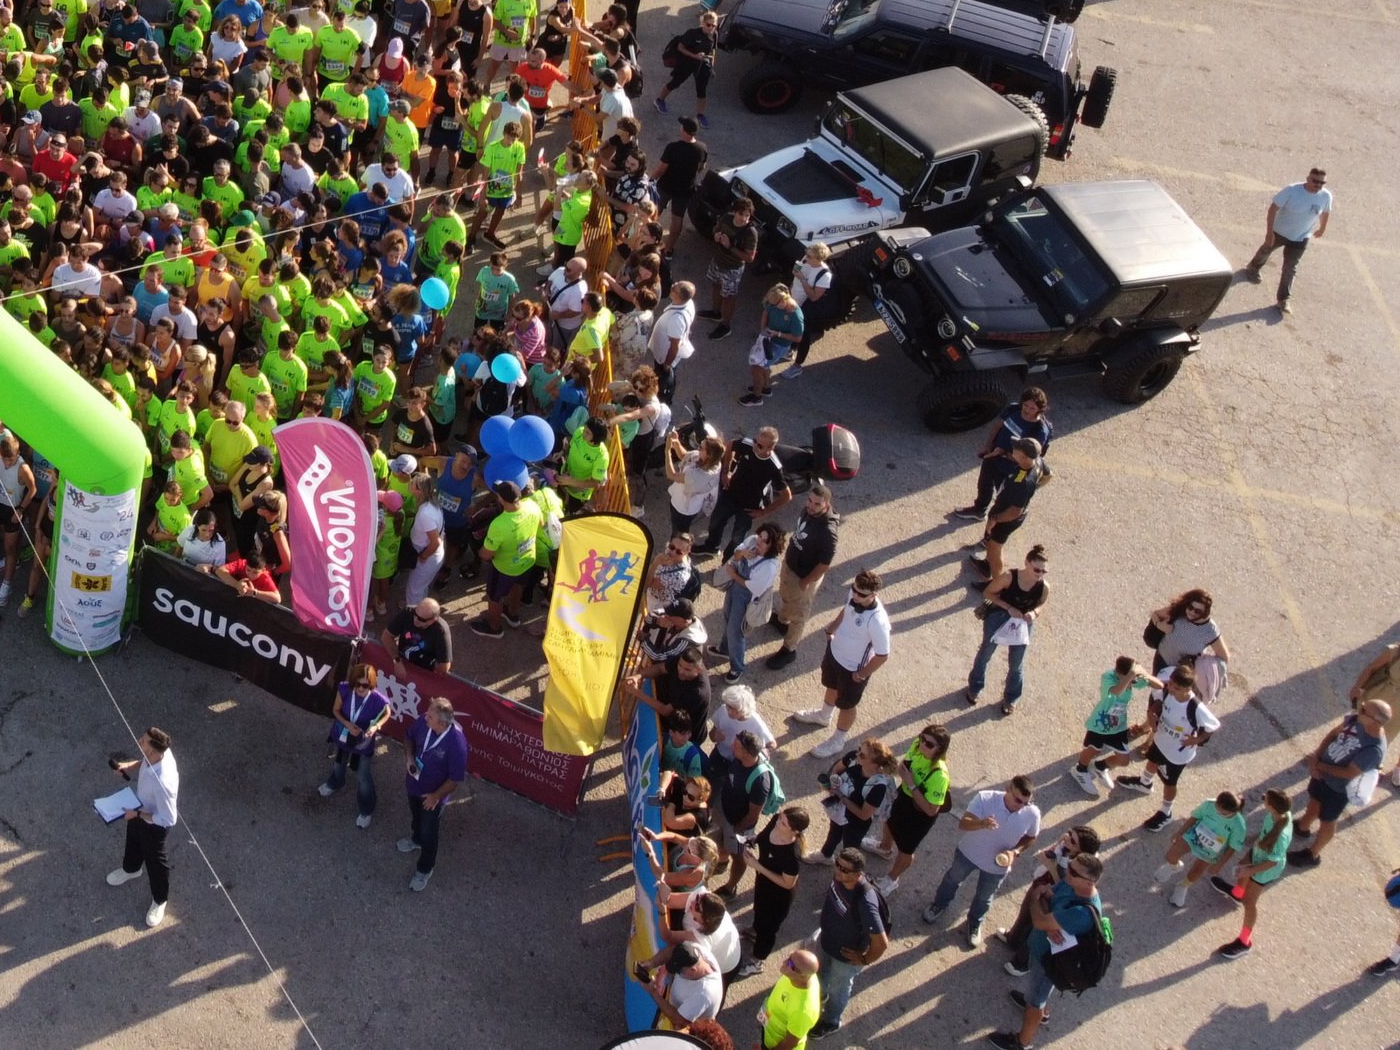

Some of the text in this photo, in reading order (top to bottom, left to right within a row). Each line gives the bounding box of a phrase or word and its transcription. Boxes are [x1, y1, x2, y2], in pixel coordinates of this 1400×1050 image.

[152, 587, 333, 687] saucony
[471, 720, 572, 771] ΗΜΙΜΑΡΑΘΩΝΙΟΣ
[521, 753, 568, 780] ΠΑΤΡΑΣ
